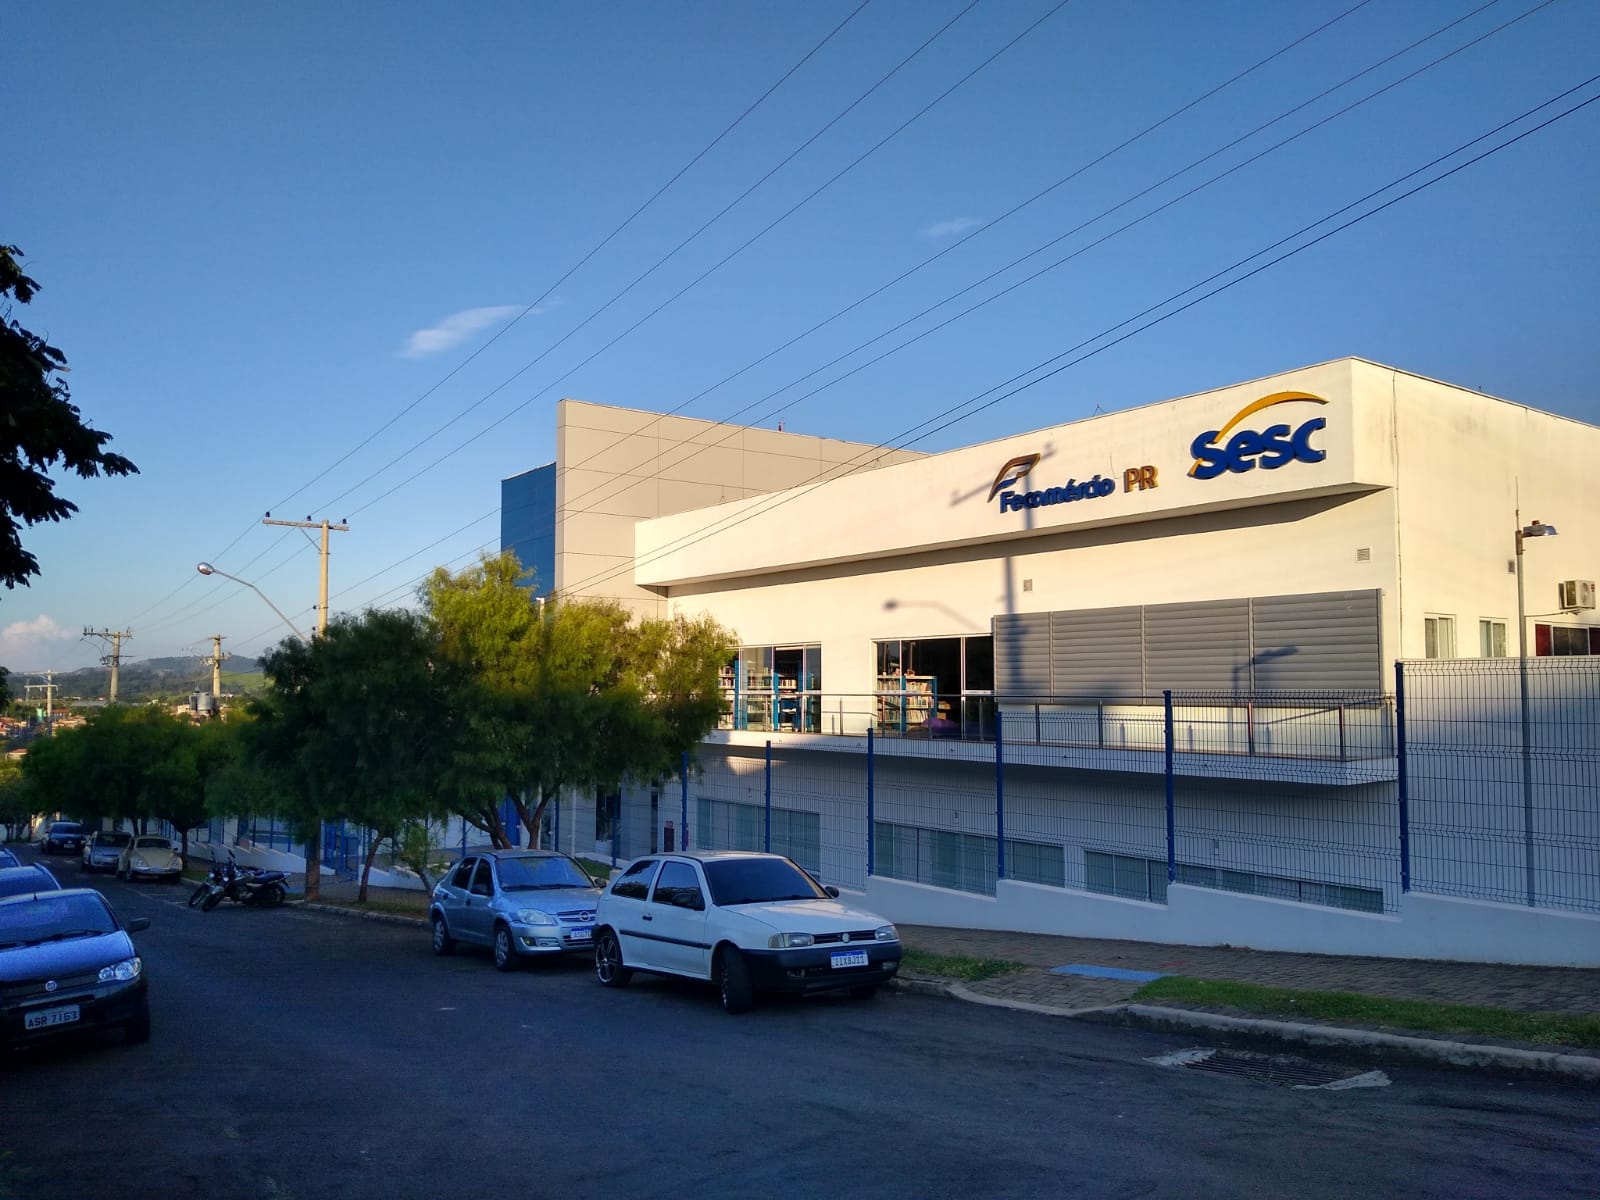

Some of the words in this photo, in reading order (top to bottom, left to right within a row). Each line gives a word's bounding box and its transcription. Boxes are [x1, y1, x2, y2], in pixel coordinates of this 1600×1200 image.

[1000, 475, 1116, 513] Fecomércio
[1124, 465, 1159, 493] PR
[28, 1015, 48, 1027] ASR
[50, 1010, 78, 1023] 7163
